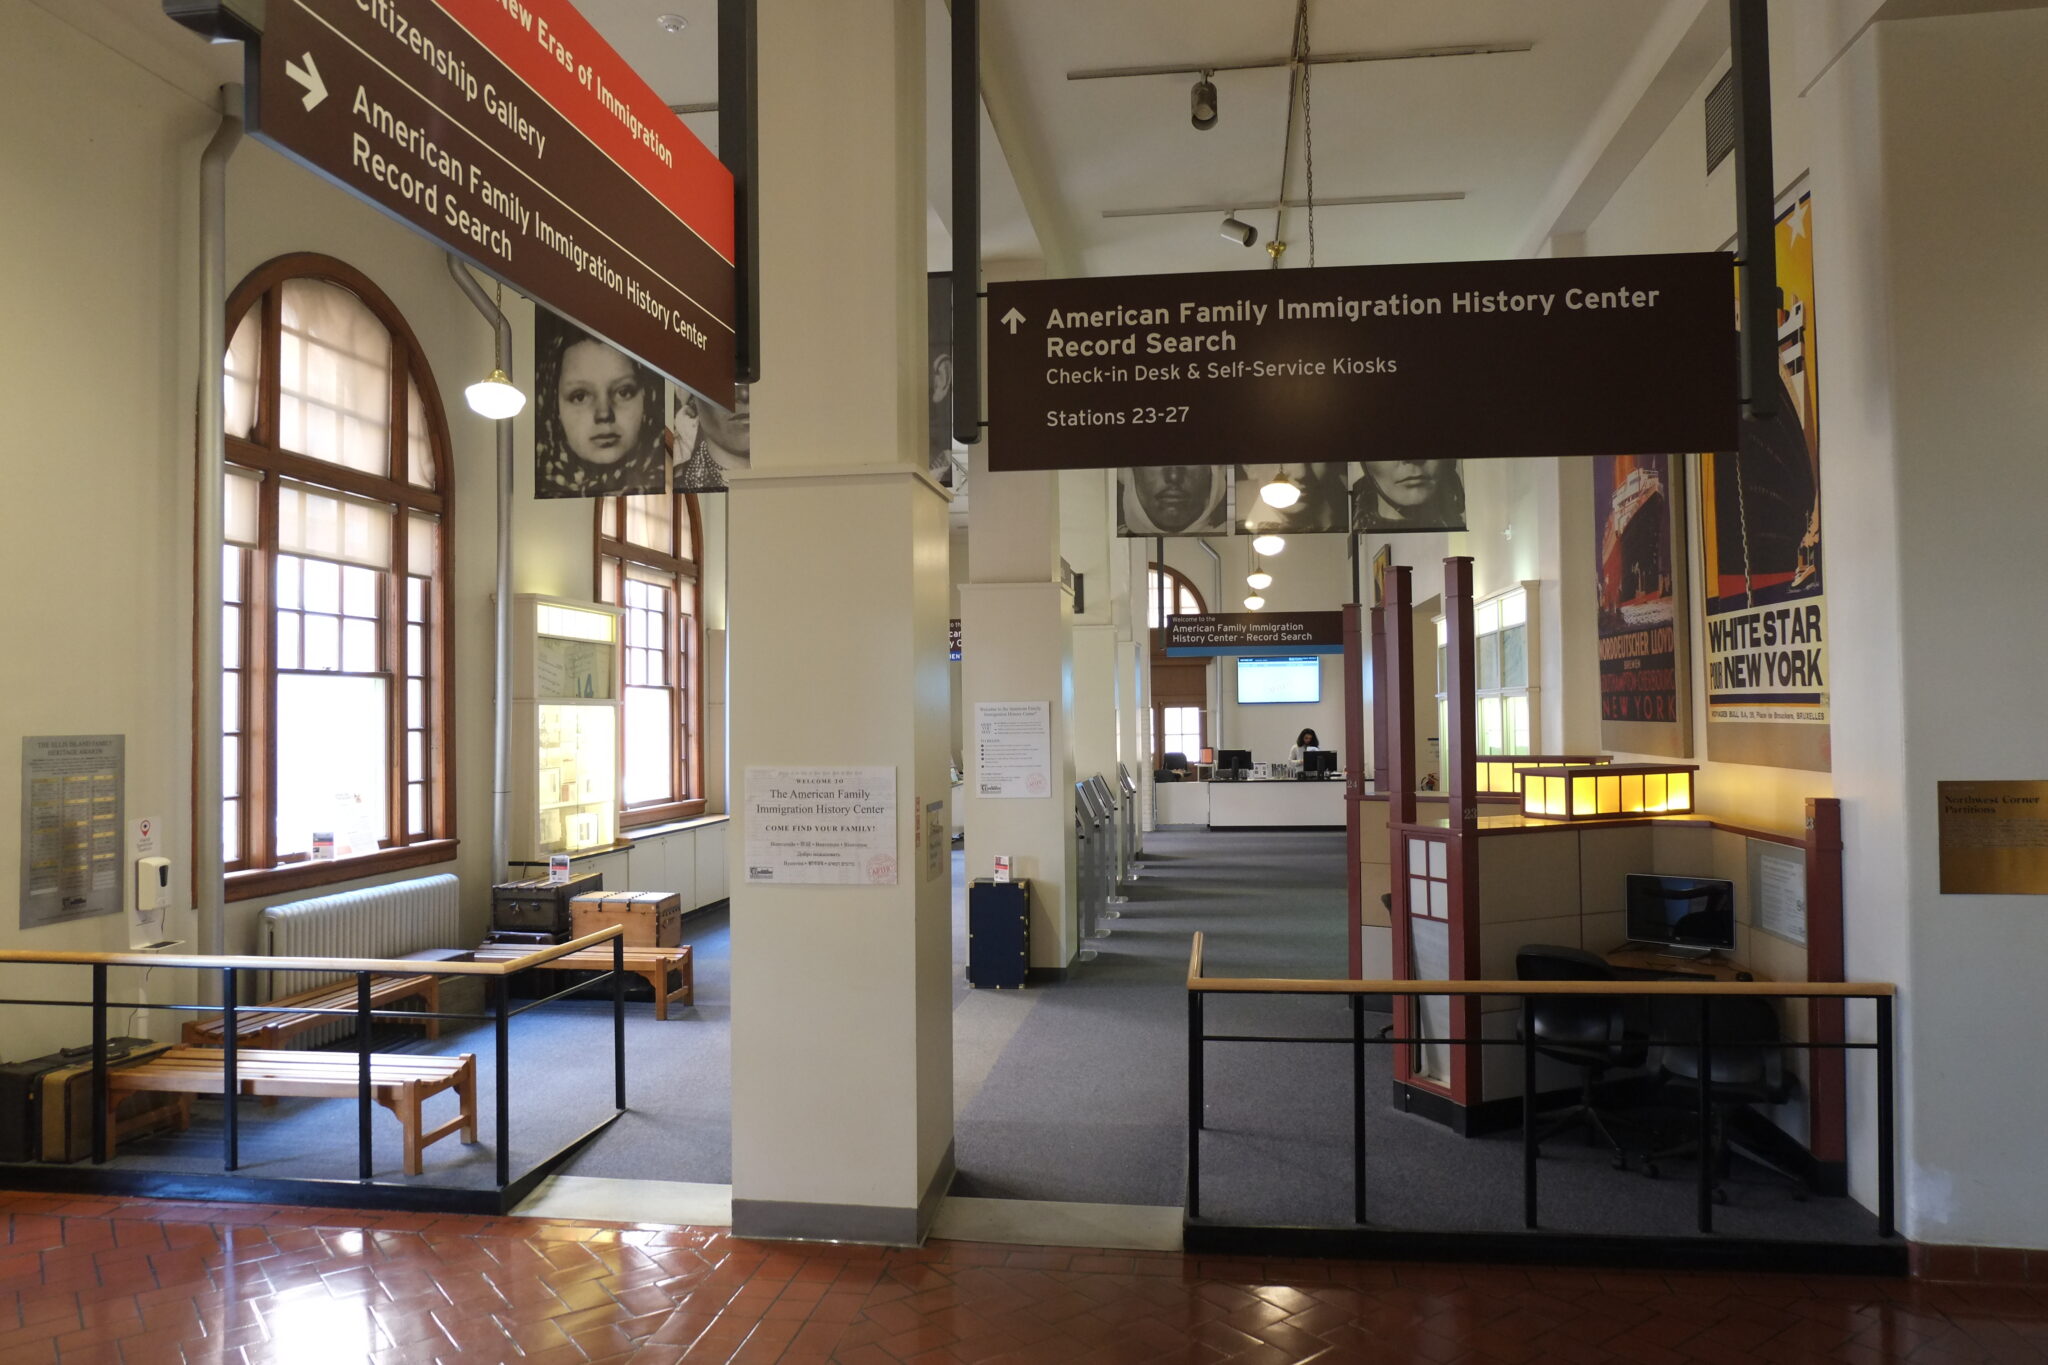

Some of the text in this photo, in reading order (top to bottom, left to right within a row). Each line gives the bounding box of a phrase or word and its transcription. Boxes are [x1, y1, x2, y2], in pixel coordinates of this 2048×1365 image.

[538, 16, 574, 73] Eras
[578, 64, 593, 91] of
[597, 76, 672, 169] Immigration
[484, 84, 546, 160] Gallery
[353, 132, 512, 262] Record Search
[353, 85, 708, 351] American Family Immigration History Center
[1046, 286, 1660, 330] American Family Immigration History Center
[1047, 330, 1237, 358] Record Search
[1046, 356, 1398, 385] Check-in Desk & Self-Service Kiosks
[1047, 406, 1190, 427] Stations 23-27
[1172, 633, 1205, 644] History
[1207, 633, 1239, 642] Center
[1246, 632, 1279, 642] Record
[1281, 632, 1313, 641] Search
[1173, 622, 1304, 633] American Family Immigration
[1708, 604, 1823, 654] WHITE STAR
[1650, 627, 1675, 655] LLOYD
[1724, 652, 1762, 689] NEW
[1764, 648, 1824, 687] YORK
[1603, 695, 1677, 720] NEW YORK
[1796, 711, 1825, 720] BRUXELLES
[769, 788, 871, 801] The American Family
[1944, 795, 2040, 804] Northwest Corner
[756, 804, 885, 816] Immigration History Center
[1463, 808, 1477, 820] 23
[1944, 805, 1996, 814] Partitions
[765, 824, 876, 832] COME FIND YOUR FAMILY!
